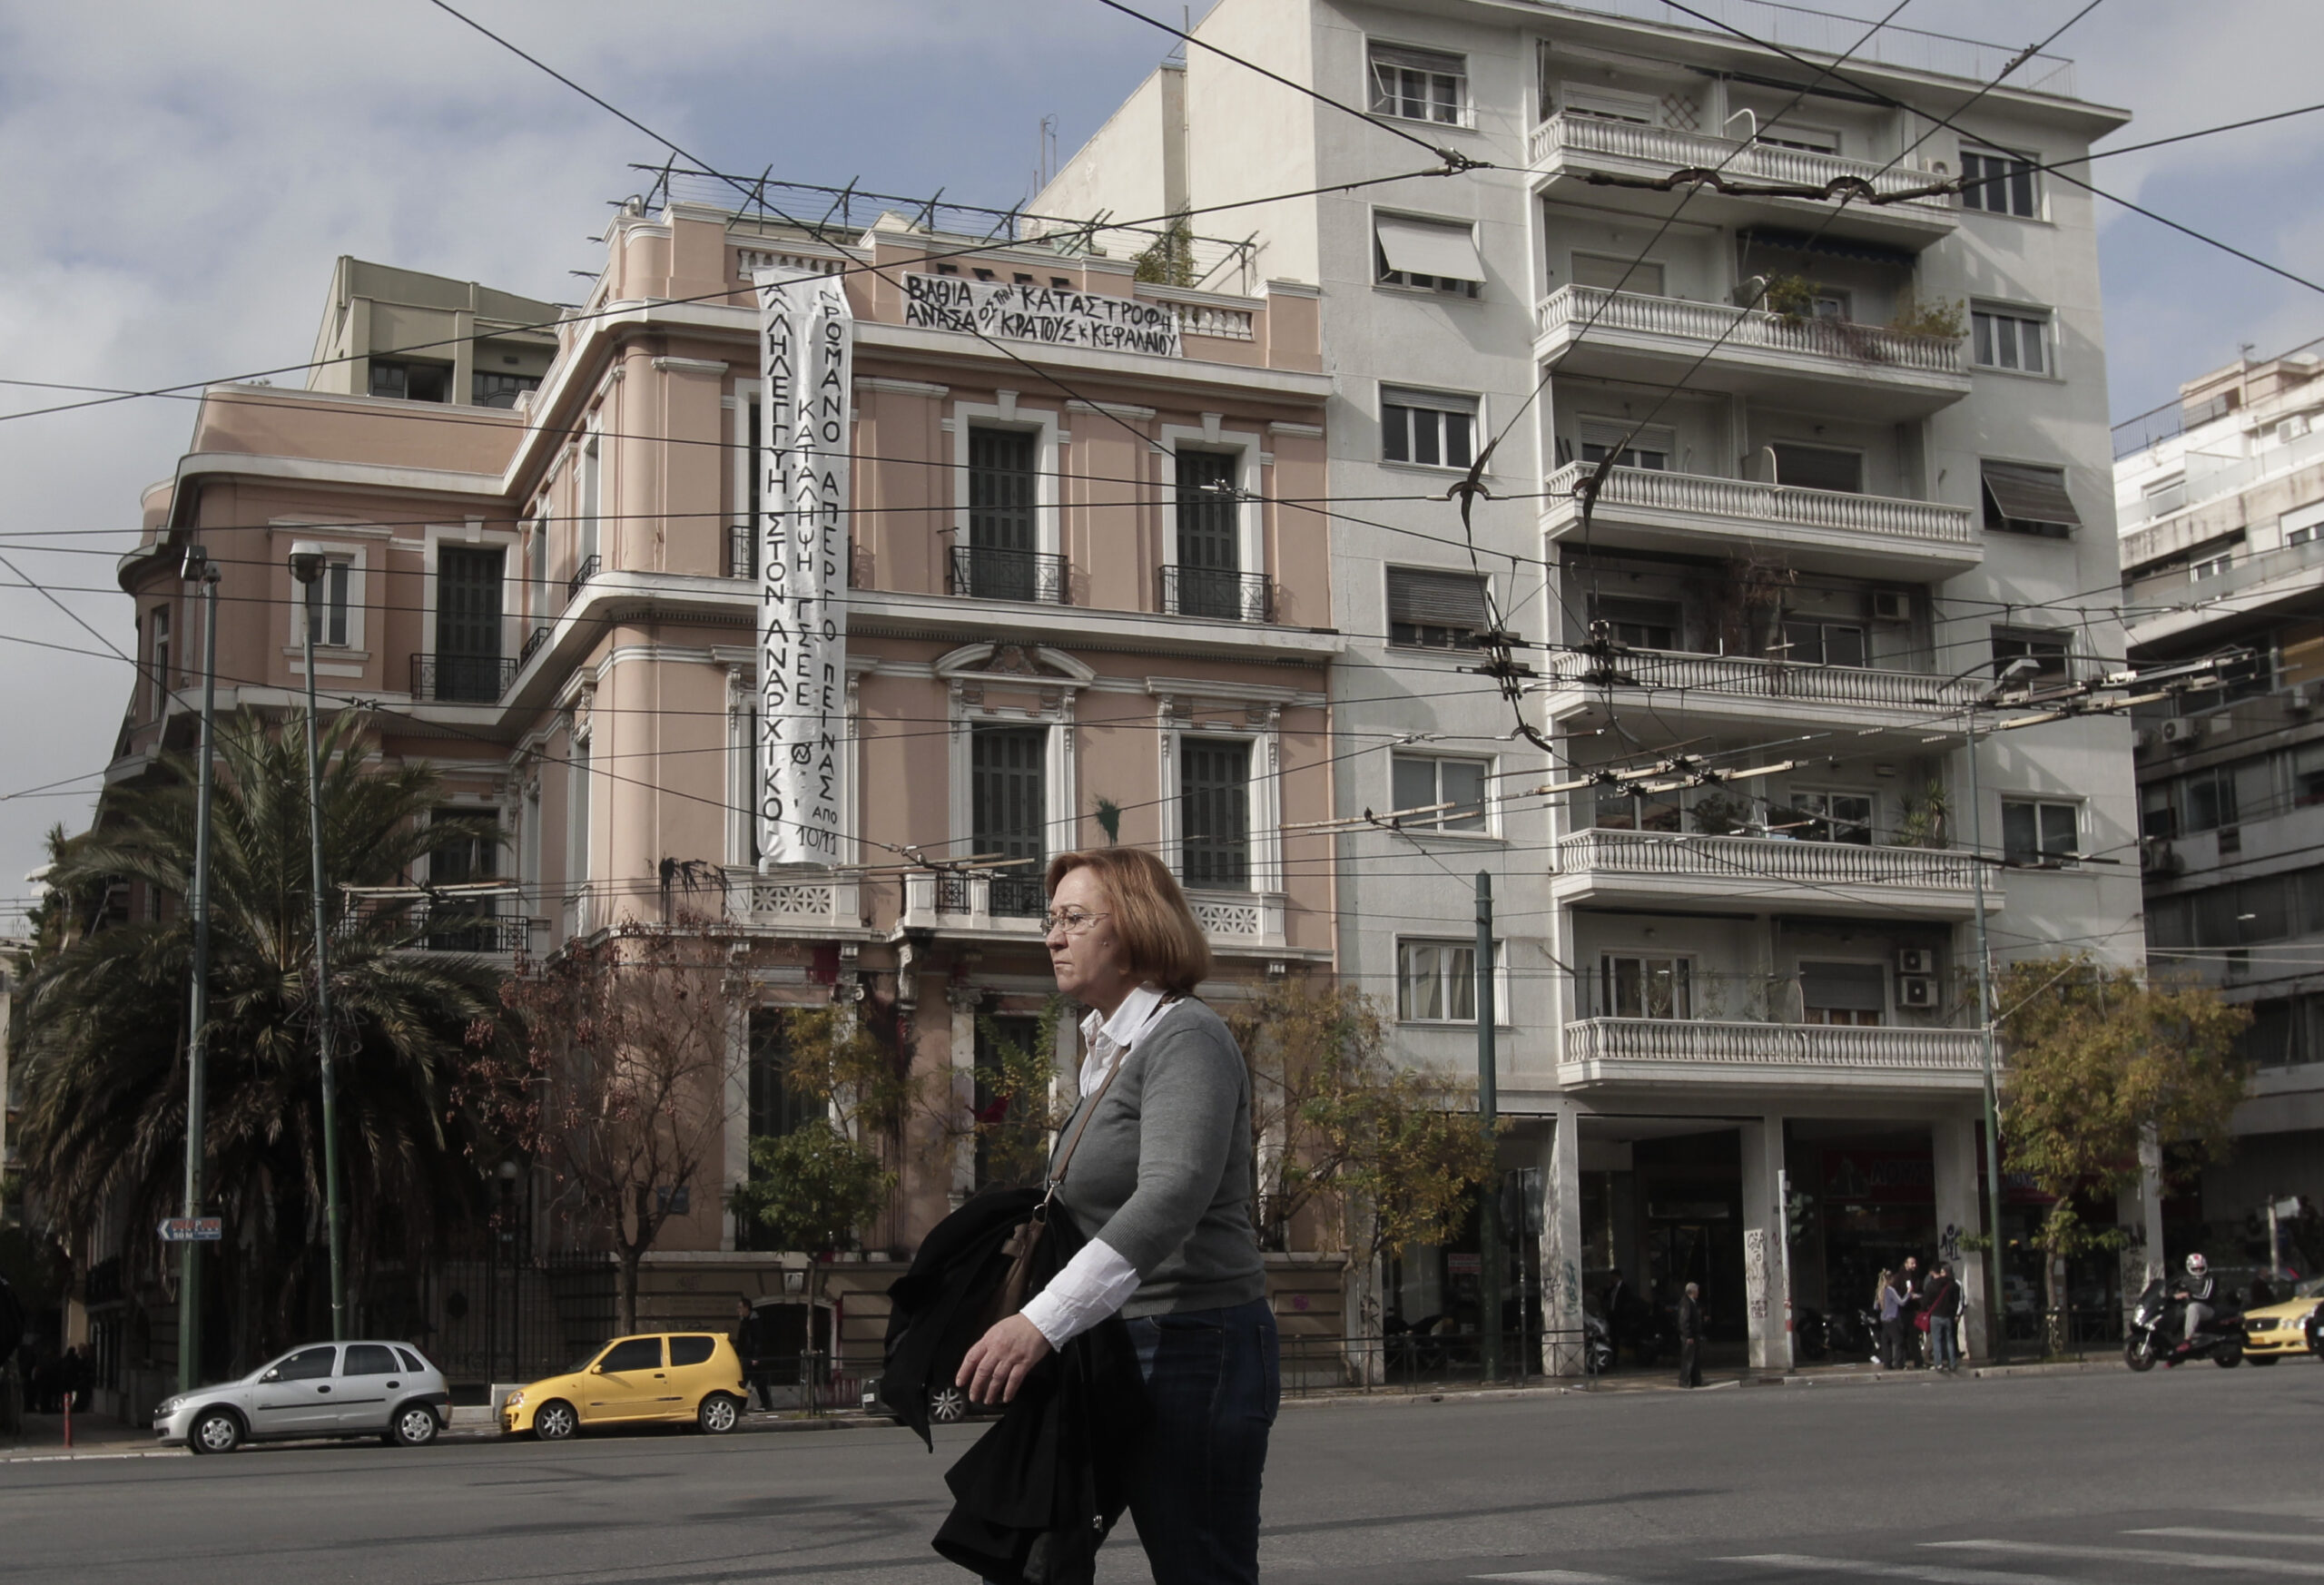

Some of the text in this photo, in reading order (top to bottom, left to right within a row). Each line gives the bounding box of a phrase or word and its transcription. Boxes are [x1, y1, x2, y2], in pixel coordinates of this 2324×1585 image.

[907, 275, 973, 307] ΒΑΘΙΑ
[906, 302, 979, 332] ΑΝΑΣΑ
[1021, 285, 1171, 333] ΚΑΤΑΣΤΡΟΦΗ
[1001, 310, 1076, 342] ΚΡΑΤΟΥΣ
[1090, 320, 1177, 357] ΚΕΦΑΛΑΙΟΥ
[762, 619, 789, 821] ΑΝΑΡΧΙΚΟ
[812, 806, 837, 824] ΑΠΟ
[796, 825, 836, 855] 10/11
